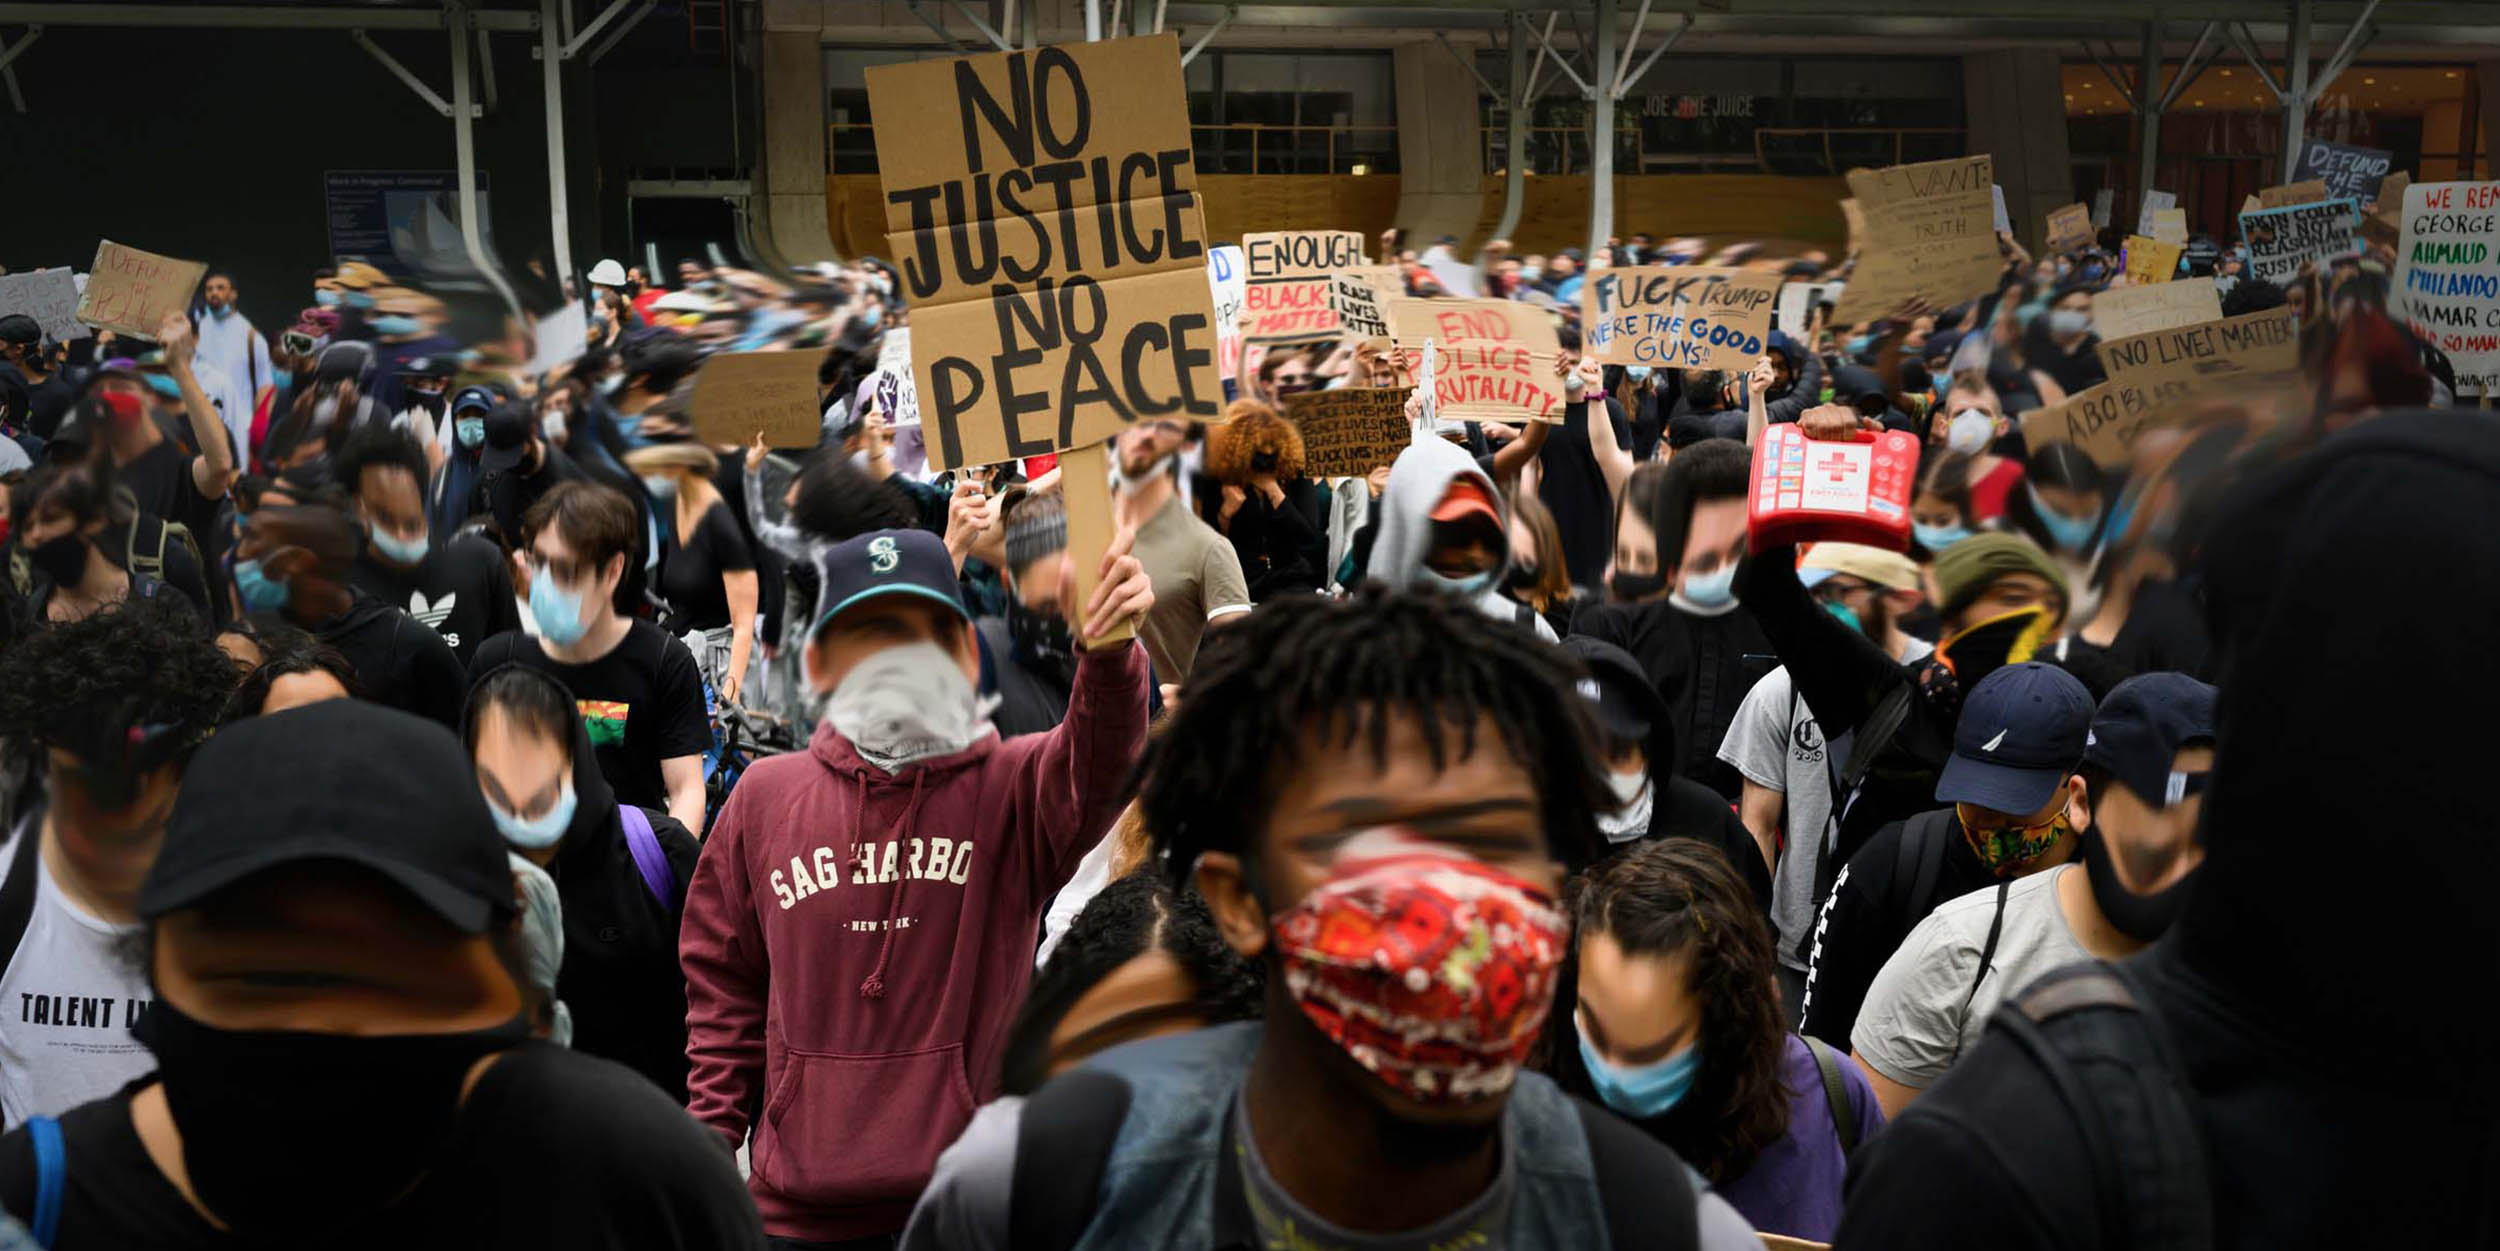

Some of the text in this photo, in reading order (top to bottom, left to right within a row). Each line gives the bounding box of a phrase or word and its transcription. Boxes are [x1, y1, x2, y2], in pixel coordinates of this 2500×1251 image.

[954, 47, 1091, 174] NO
[1641, 95, 1669, 117] JOE
[1712, 94, 1753, 118] JUICE
[2308, 145, 2391, 177] DEFUND
[2317, 170, 2366, 191] THE
[2426, 187, 2452, 208] WE
[888, 149, 1203, 298] JUSTICE
[1913, 217, 1967, 241] TRUTH
[2242, 203, 2353, 229] SKIN COLOR
[2296, 217, 2336, 240] NOT
[2414, 215, 2495, 235] GEORGE
[1249, 235, 1362, 276] ENOUGH
[2411, 241, 2487, 265] AHMAUD
[1247, 283, 1327, 312] BLACK
[1595, 273, 1700, 312] FUCK
[2407, 266, 2499, 299] PHILANDO
[991, 274, 1108, 355] NO
[1341, 297, 1379, 320] LIVES
[1436, 309, 1511, 345] END
[1645, 313, 1685, 334] THE
[1689, 318, 1761, 355] GOOD
[2443, 333, 2463, 352] SO
[2466, 334, 2500, 352] MAN
[2109, 340, 2148, 371] NO
[2155, 326, 2217, 364] LIVES
[931, 314, 1218, 471] PEACE
[1434, 374, 1557, 418] RUTALITY
[770, 846, 839, 910] SAG
[851, 917, 910, 932] NEW YRK
[21, 992, 115, 1028] TALENT
